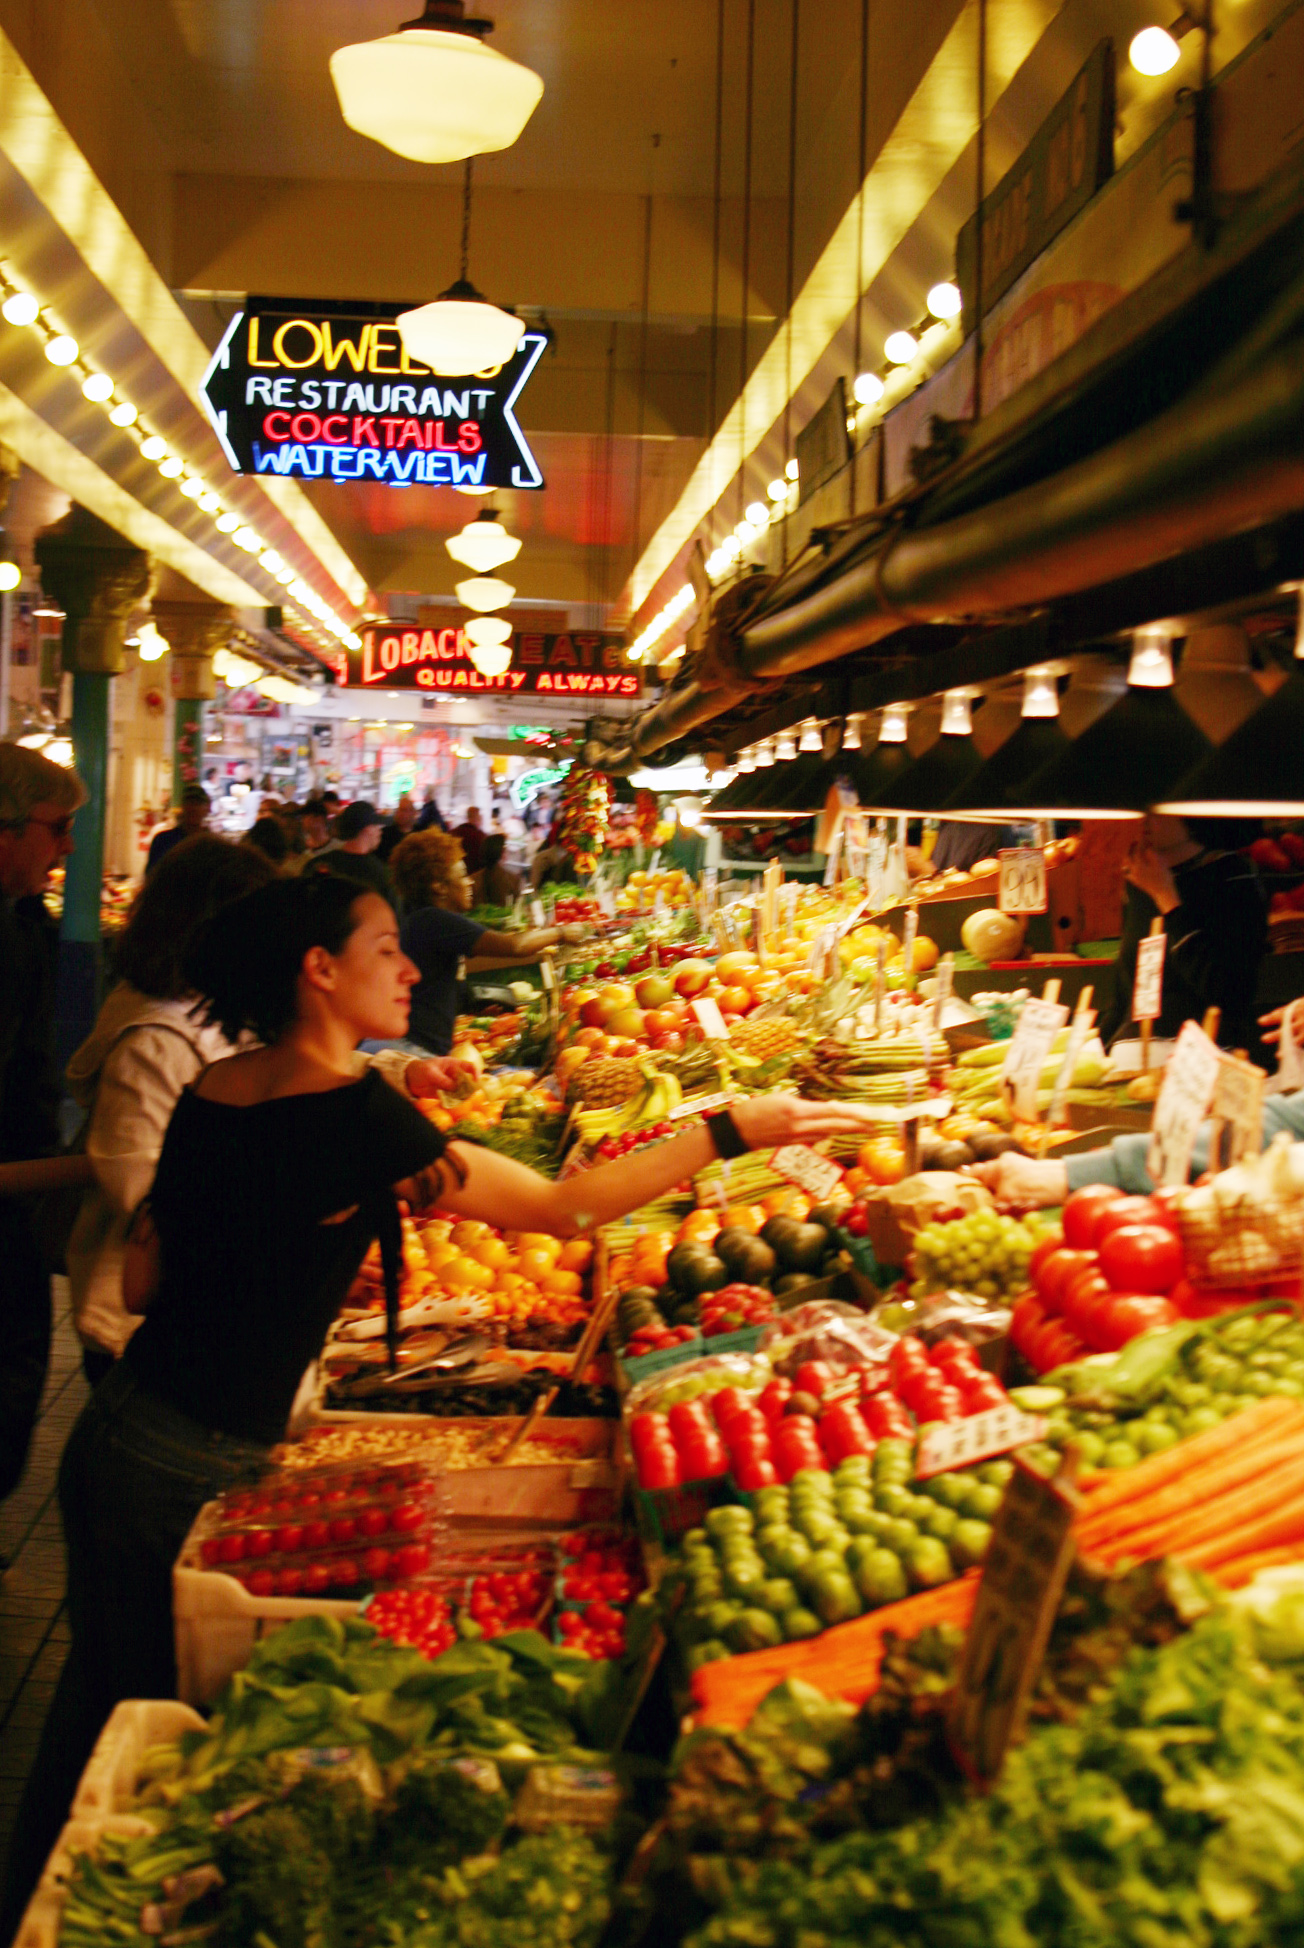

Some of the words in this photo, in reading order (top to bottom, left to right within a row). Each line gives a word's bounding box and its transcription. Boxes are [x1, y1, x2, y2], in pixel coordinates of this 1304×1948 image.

[245, 376, 496, 419] RESTAURANT
[262, 411, 482, 454] COCKTAILS
[252, 441, 488, 485] WATERVIEW
[510, 633, 600, 667] EAT
[416, 667, 526, 690] QUALITY
[536, 671, 638, 694] ALWAYS
